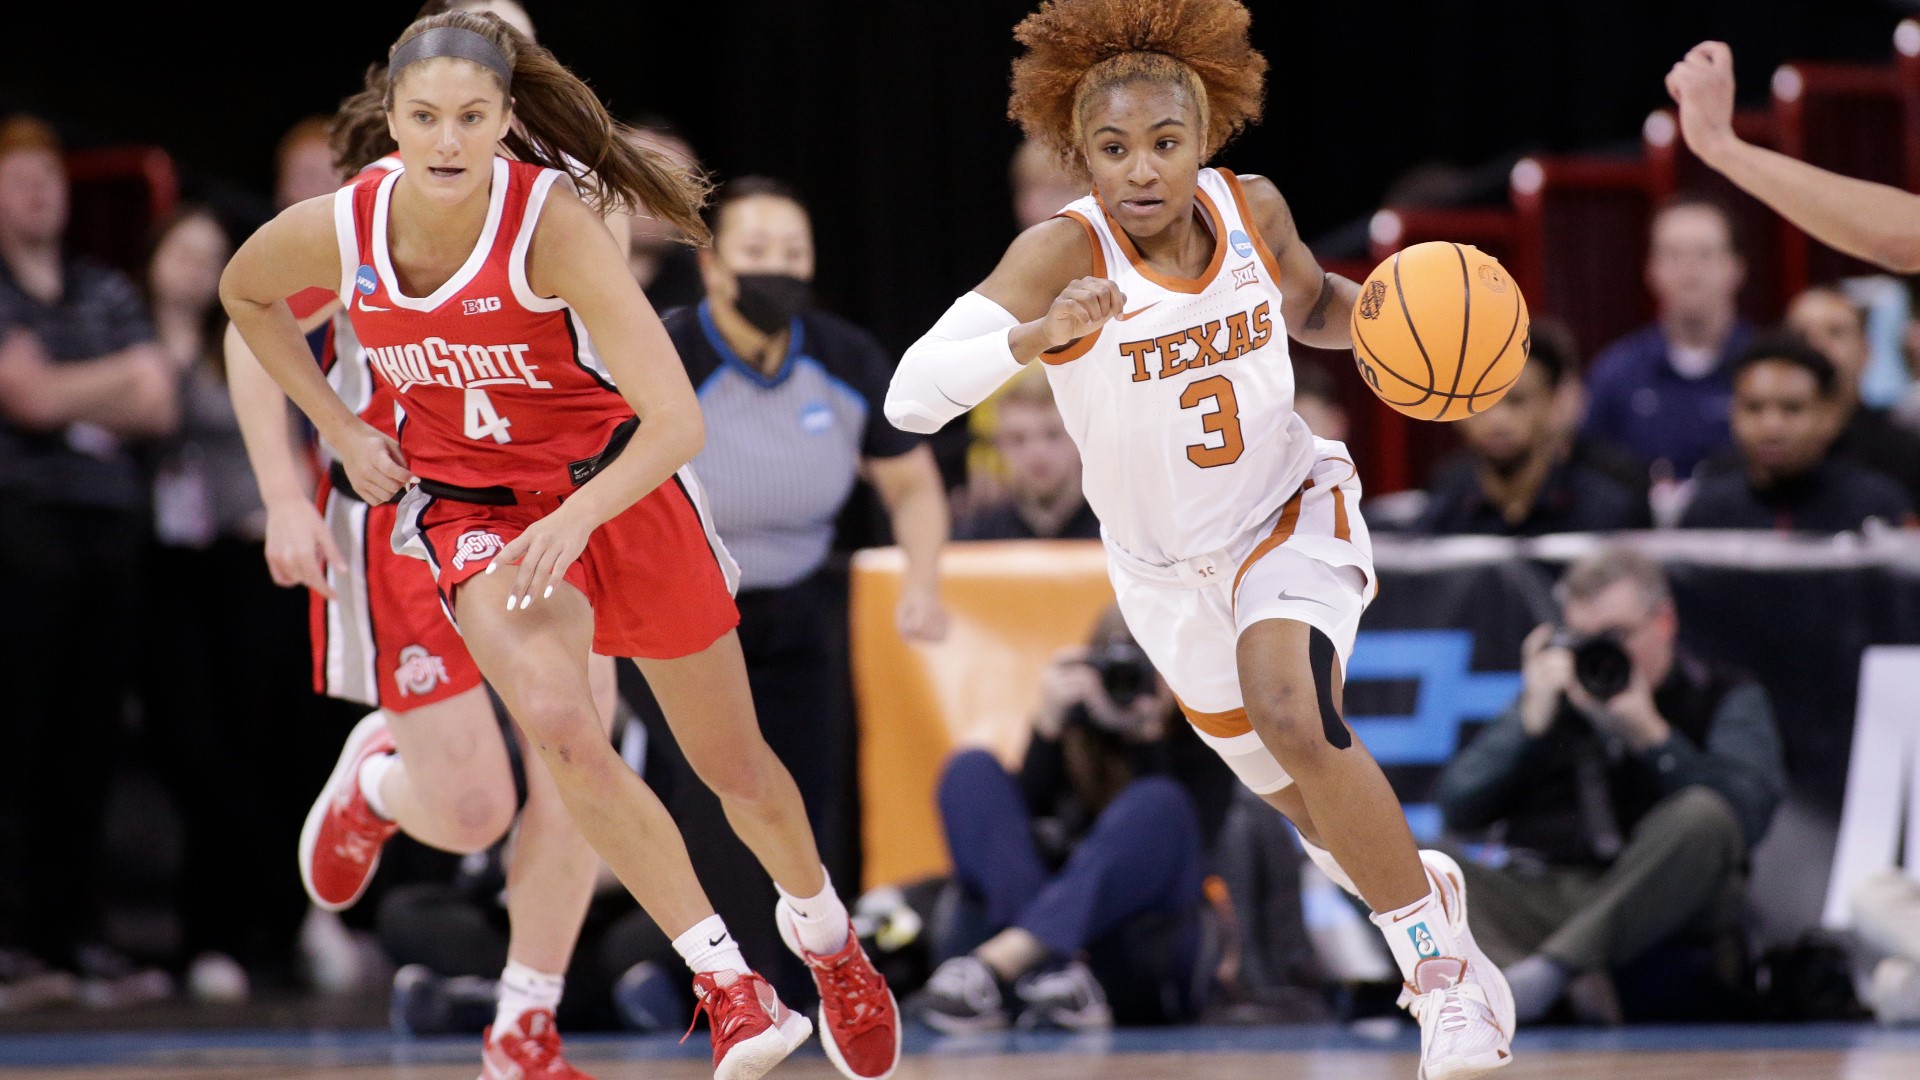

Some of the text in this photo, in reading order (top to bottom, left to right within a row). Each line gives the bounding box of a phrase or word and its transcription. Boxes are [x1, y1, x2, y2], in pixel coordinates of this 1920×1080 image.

[357, 275, 376, 291] NCAA
[1119, 300, 1273, 382] TEXAS
[463, 388, 512, 444] 4
[1179, 374, 1245, 468] 3
